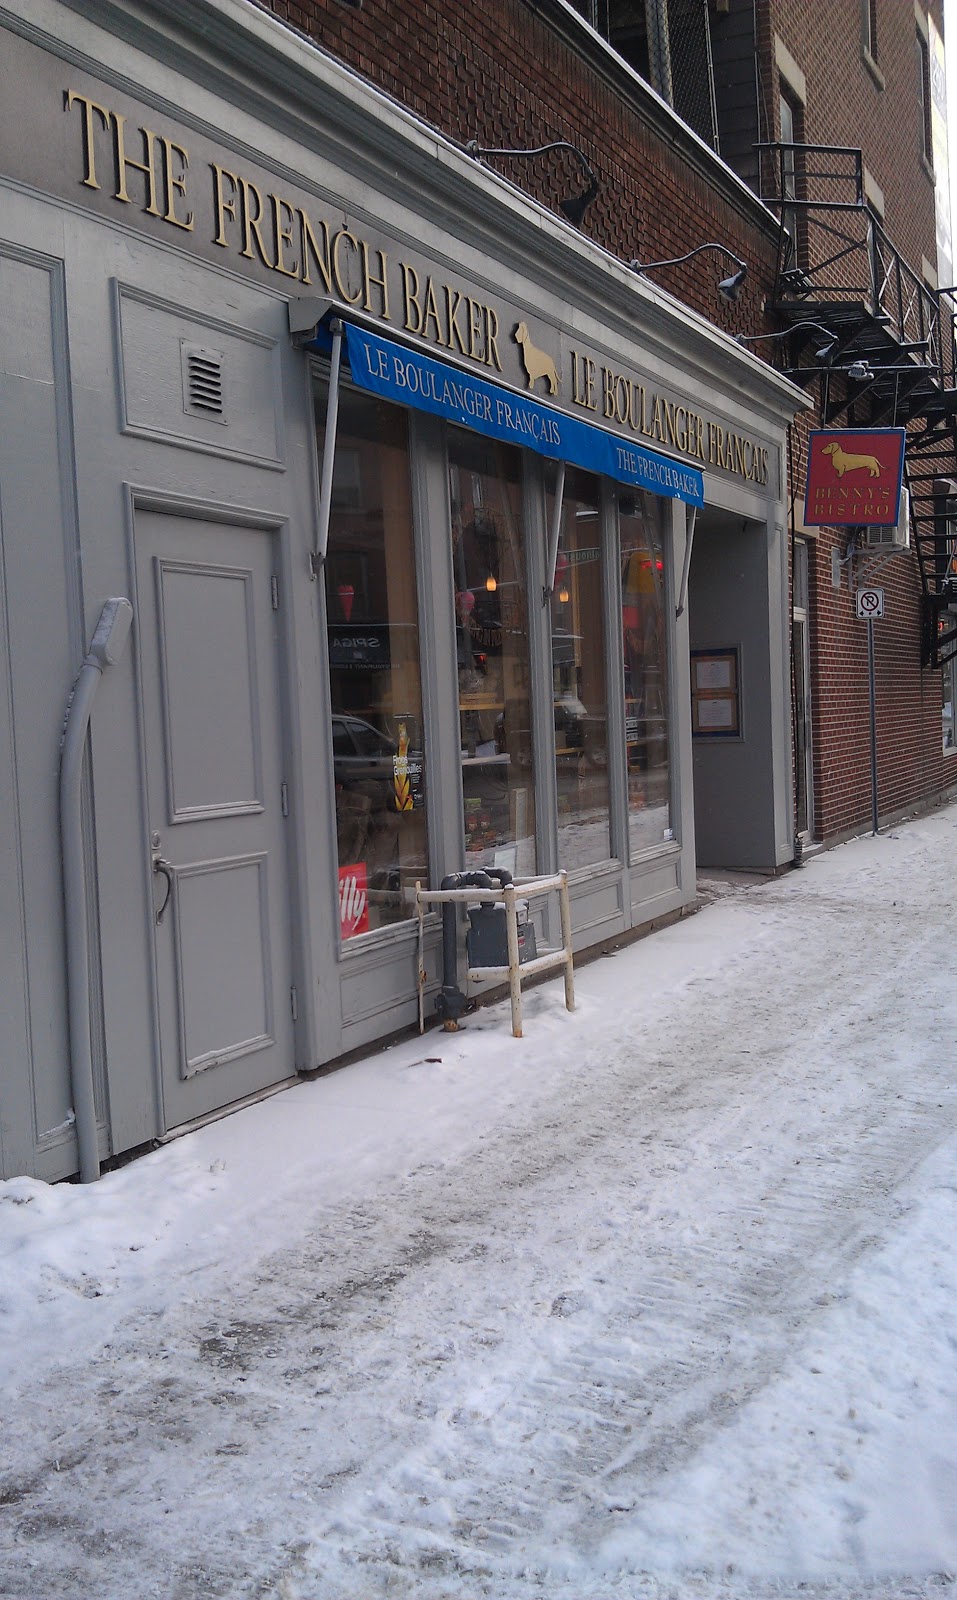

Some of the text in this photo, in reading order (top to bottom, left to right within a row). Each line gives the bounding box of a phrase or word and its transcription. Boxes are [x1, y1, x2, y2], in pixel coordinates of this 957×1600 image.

[64, 88, 504, 372] THE FRENCH BAKER
[363, 342, 561, 445] LE BOULANGER FRANÇAIS
[570, 350, 770, 485] LE BOULANGER FRANÇAIS
[616, 447, 700, 498] THE FRENCH BAKER
[814, 504, 889, 516] BISTRO
[815, 487, 890, 499] BENNY'S
